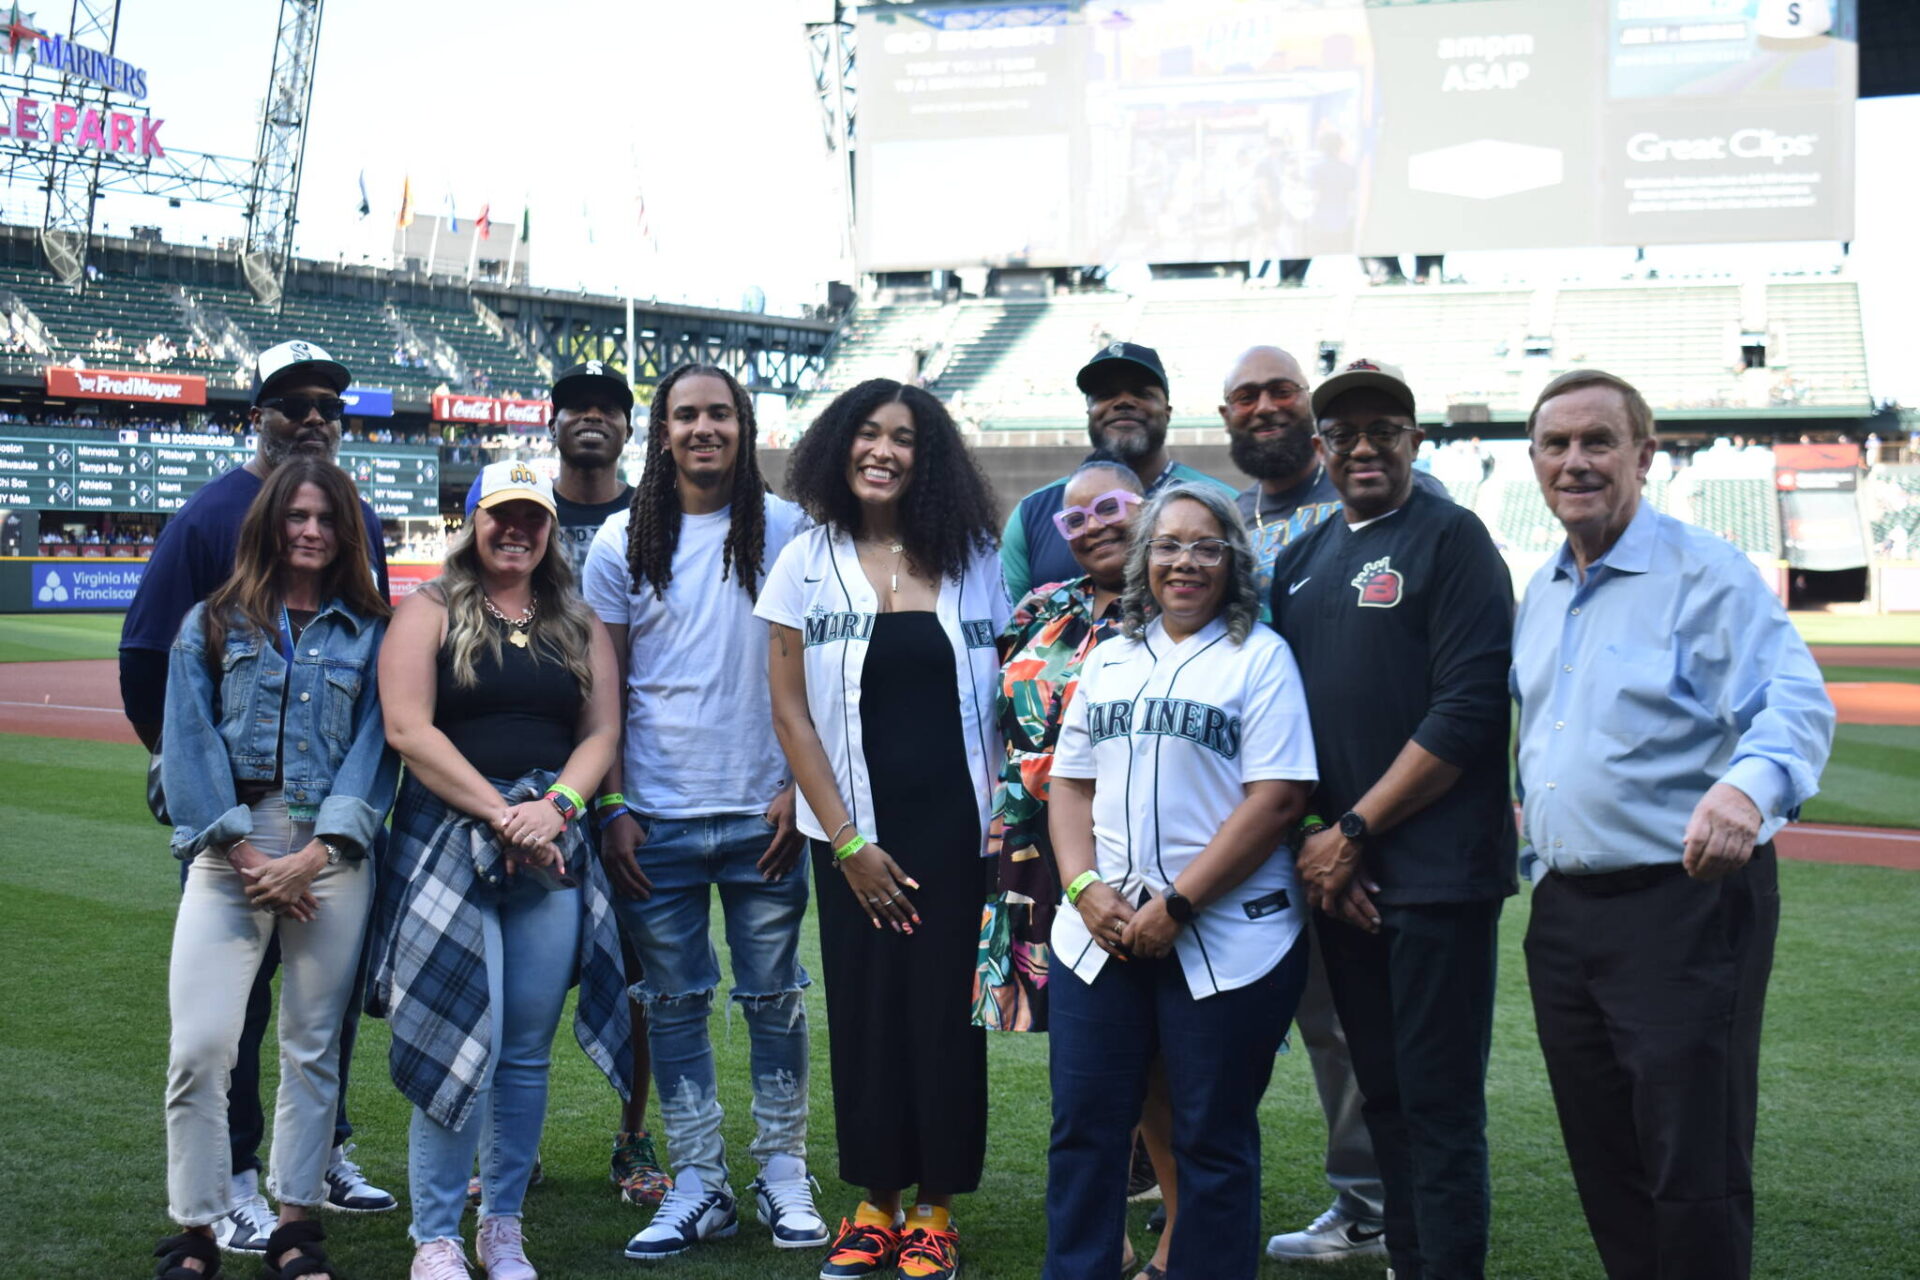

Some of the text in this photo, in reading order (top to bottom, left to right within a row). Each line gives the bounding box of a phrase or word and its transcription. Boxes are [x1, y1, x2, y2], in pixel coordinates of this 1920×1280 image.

[37, 30, 147, 101] MARINERS
[1442, 62, 1530, 92] ASAP
[0, 97, 166, 158] E PARK
[1626, 128, 1819, 164] Great Clips
[171, 433, 235, 447] SCOREBOARD
[0, 444, 24, 454] oston
[78, 446, 119, 457] Minnesota
[158, 449, 197, 462] Pittsburgh
[79, 461, 106, 474] Tampa
[107, 463, 124, 475] Bay
[158, 465, 188, 476] Arizona
[79, 480, 112, 491] Athletics
[158, 482, 181, 492] Miami
[78, 496, 112, 507] Houston
[73, 572, 142, 588] Virginia Ma
